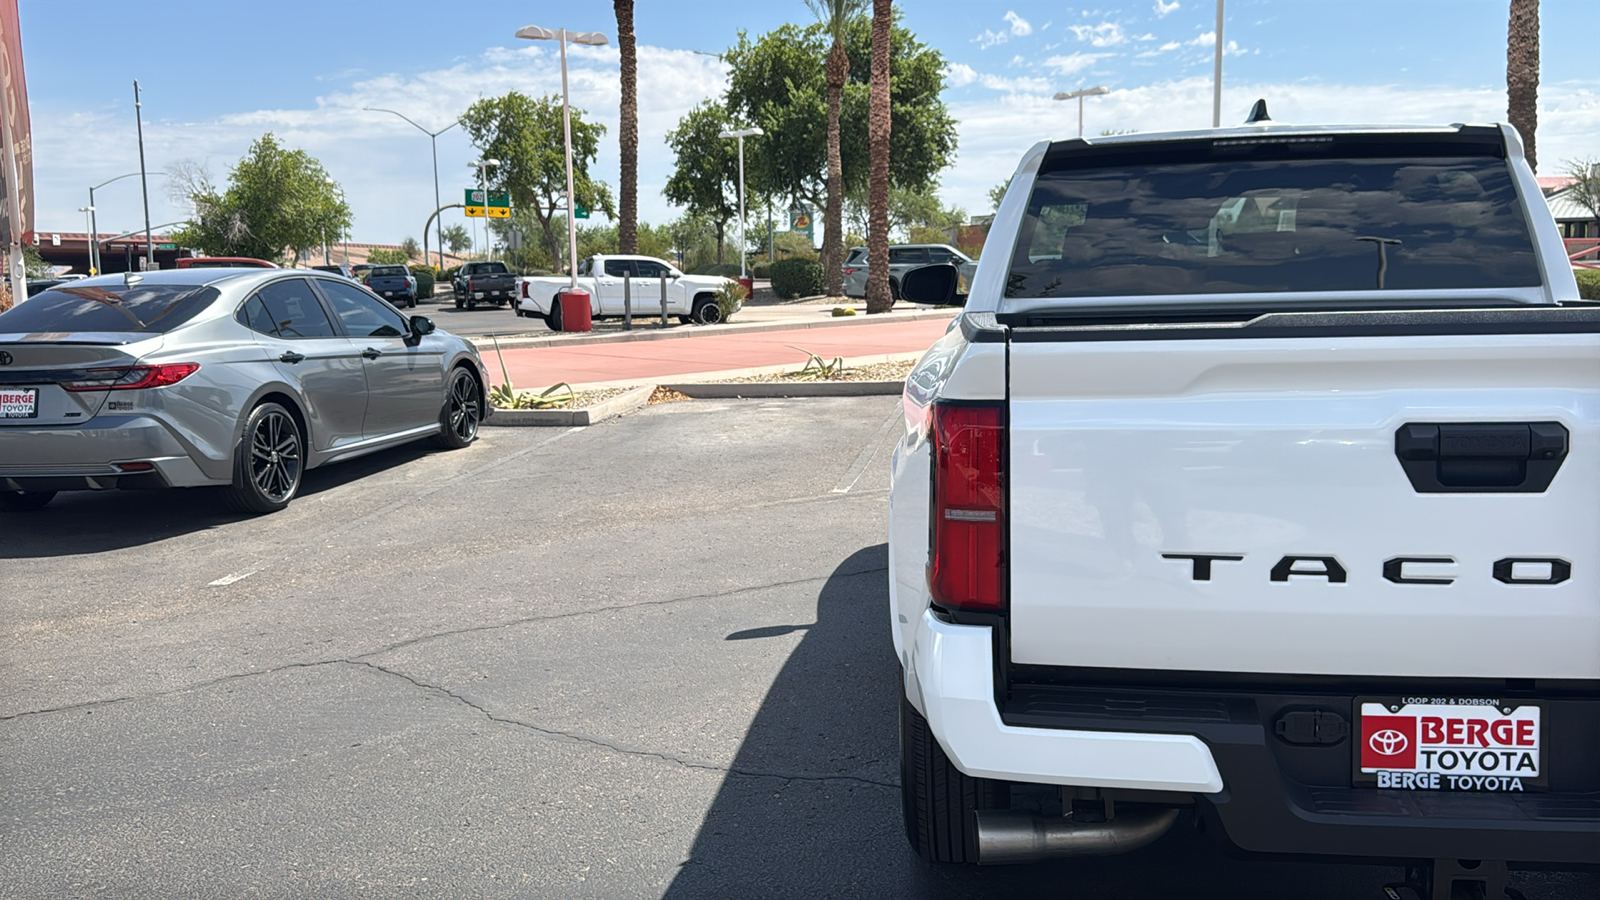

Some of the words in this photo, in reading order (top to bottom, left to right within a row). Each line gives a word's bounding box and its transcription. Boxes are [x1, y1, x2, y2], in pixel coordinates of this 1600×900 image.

[3, 394, 34, 404] BERGE
[1444, 436, 1526, 448] TOYOTA
[1161, 553, 1572, 585] TACO
[1402, 697, 1429, 705] LOOP
[1458, 698, 1500, 706] DOBSON
[1420, 716, 1535, 748] BERGE
[1420, 751, 1537, 771] TOYOTA
[1376, 771, 1441, 790] BERGE
[1447, 776, 1524, 791] TOYOTA
